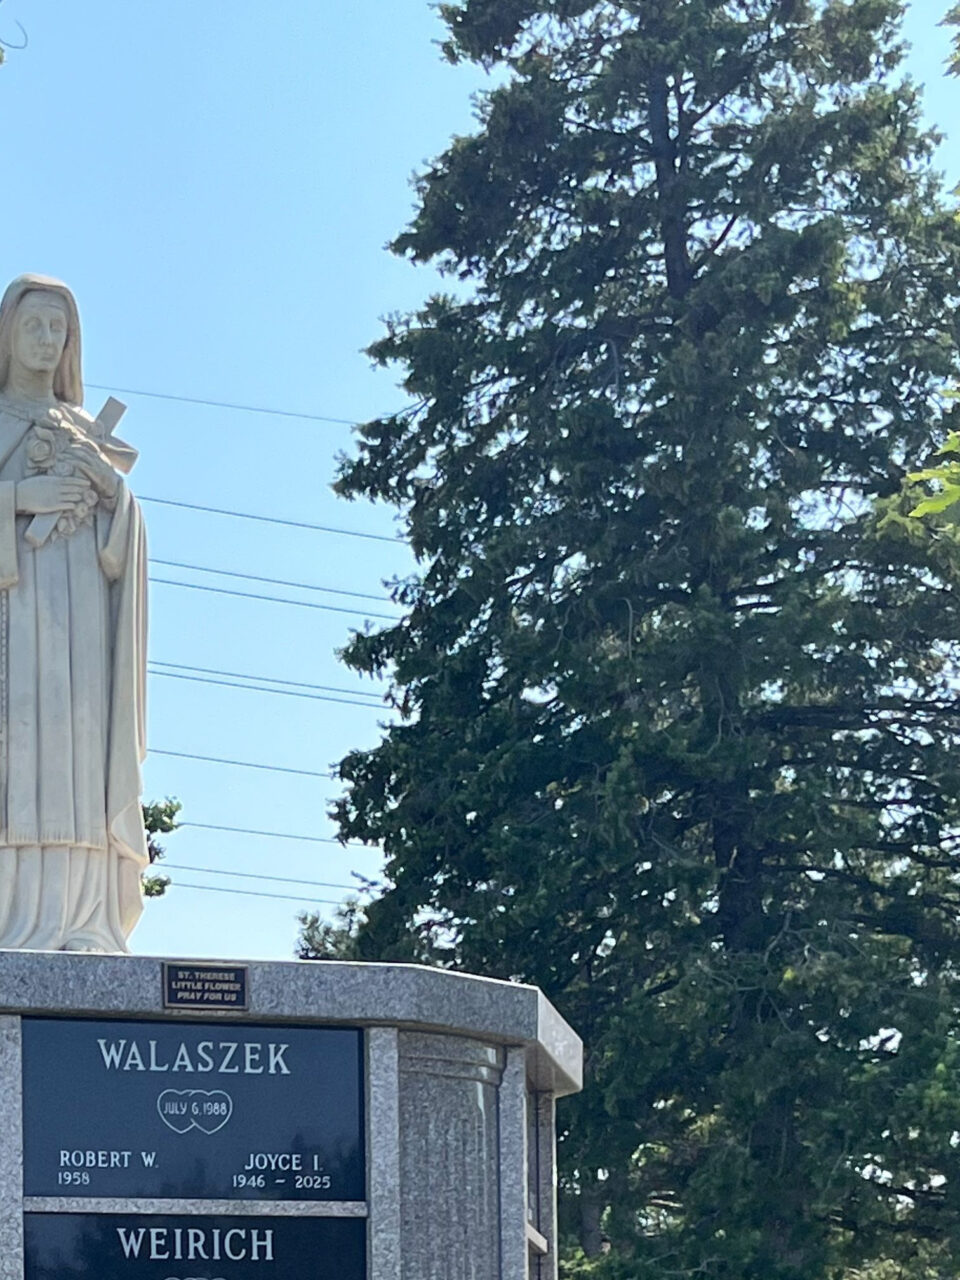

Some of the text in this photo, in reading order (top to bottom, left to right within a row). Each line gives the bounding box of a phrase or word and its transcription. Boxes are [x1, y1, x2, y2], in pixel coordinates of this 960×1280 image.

[194, 972, 235, 980] THERESE
[172, 981, 241, 990] LITTLE FLOWER
[177, 992, 202, 1000] PRAY
[224, 993, 237, 1001] US
[97, 1039, 291, 1075] WALASZEK
[164, 1102, 188, 1115] JULY
[60, 1151, 159, 1168] ROBERT W.
[245, 1154, 302, 1171] JOYCE
[58, 1172, 90, 1185] 1958
[232, 1175, 265, 1188] 1946
[295, 1176, 331, 1189] 2025
[117, 1228, 274, 1260] WEIRICH
